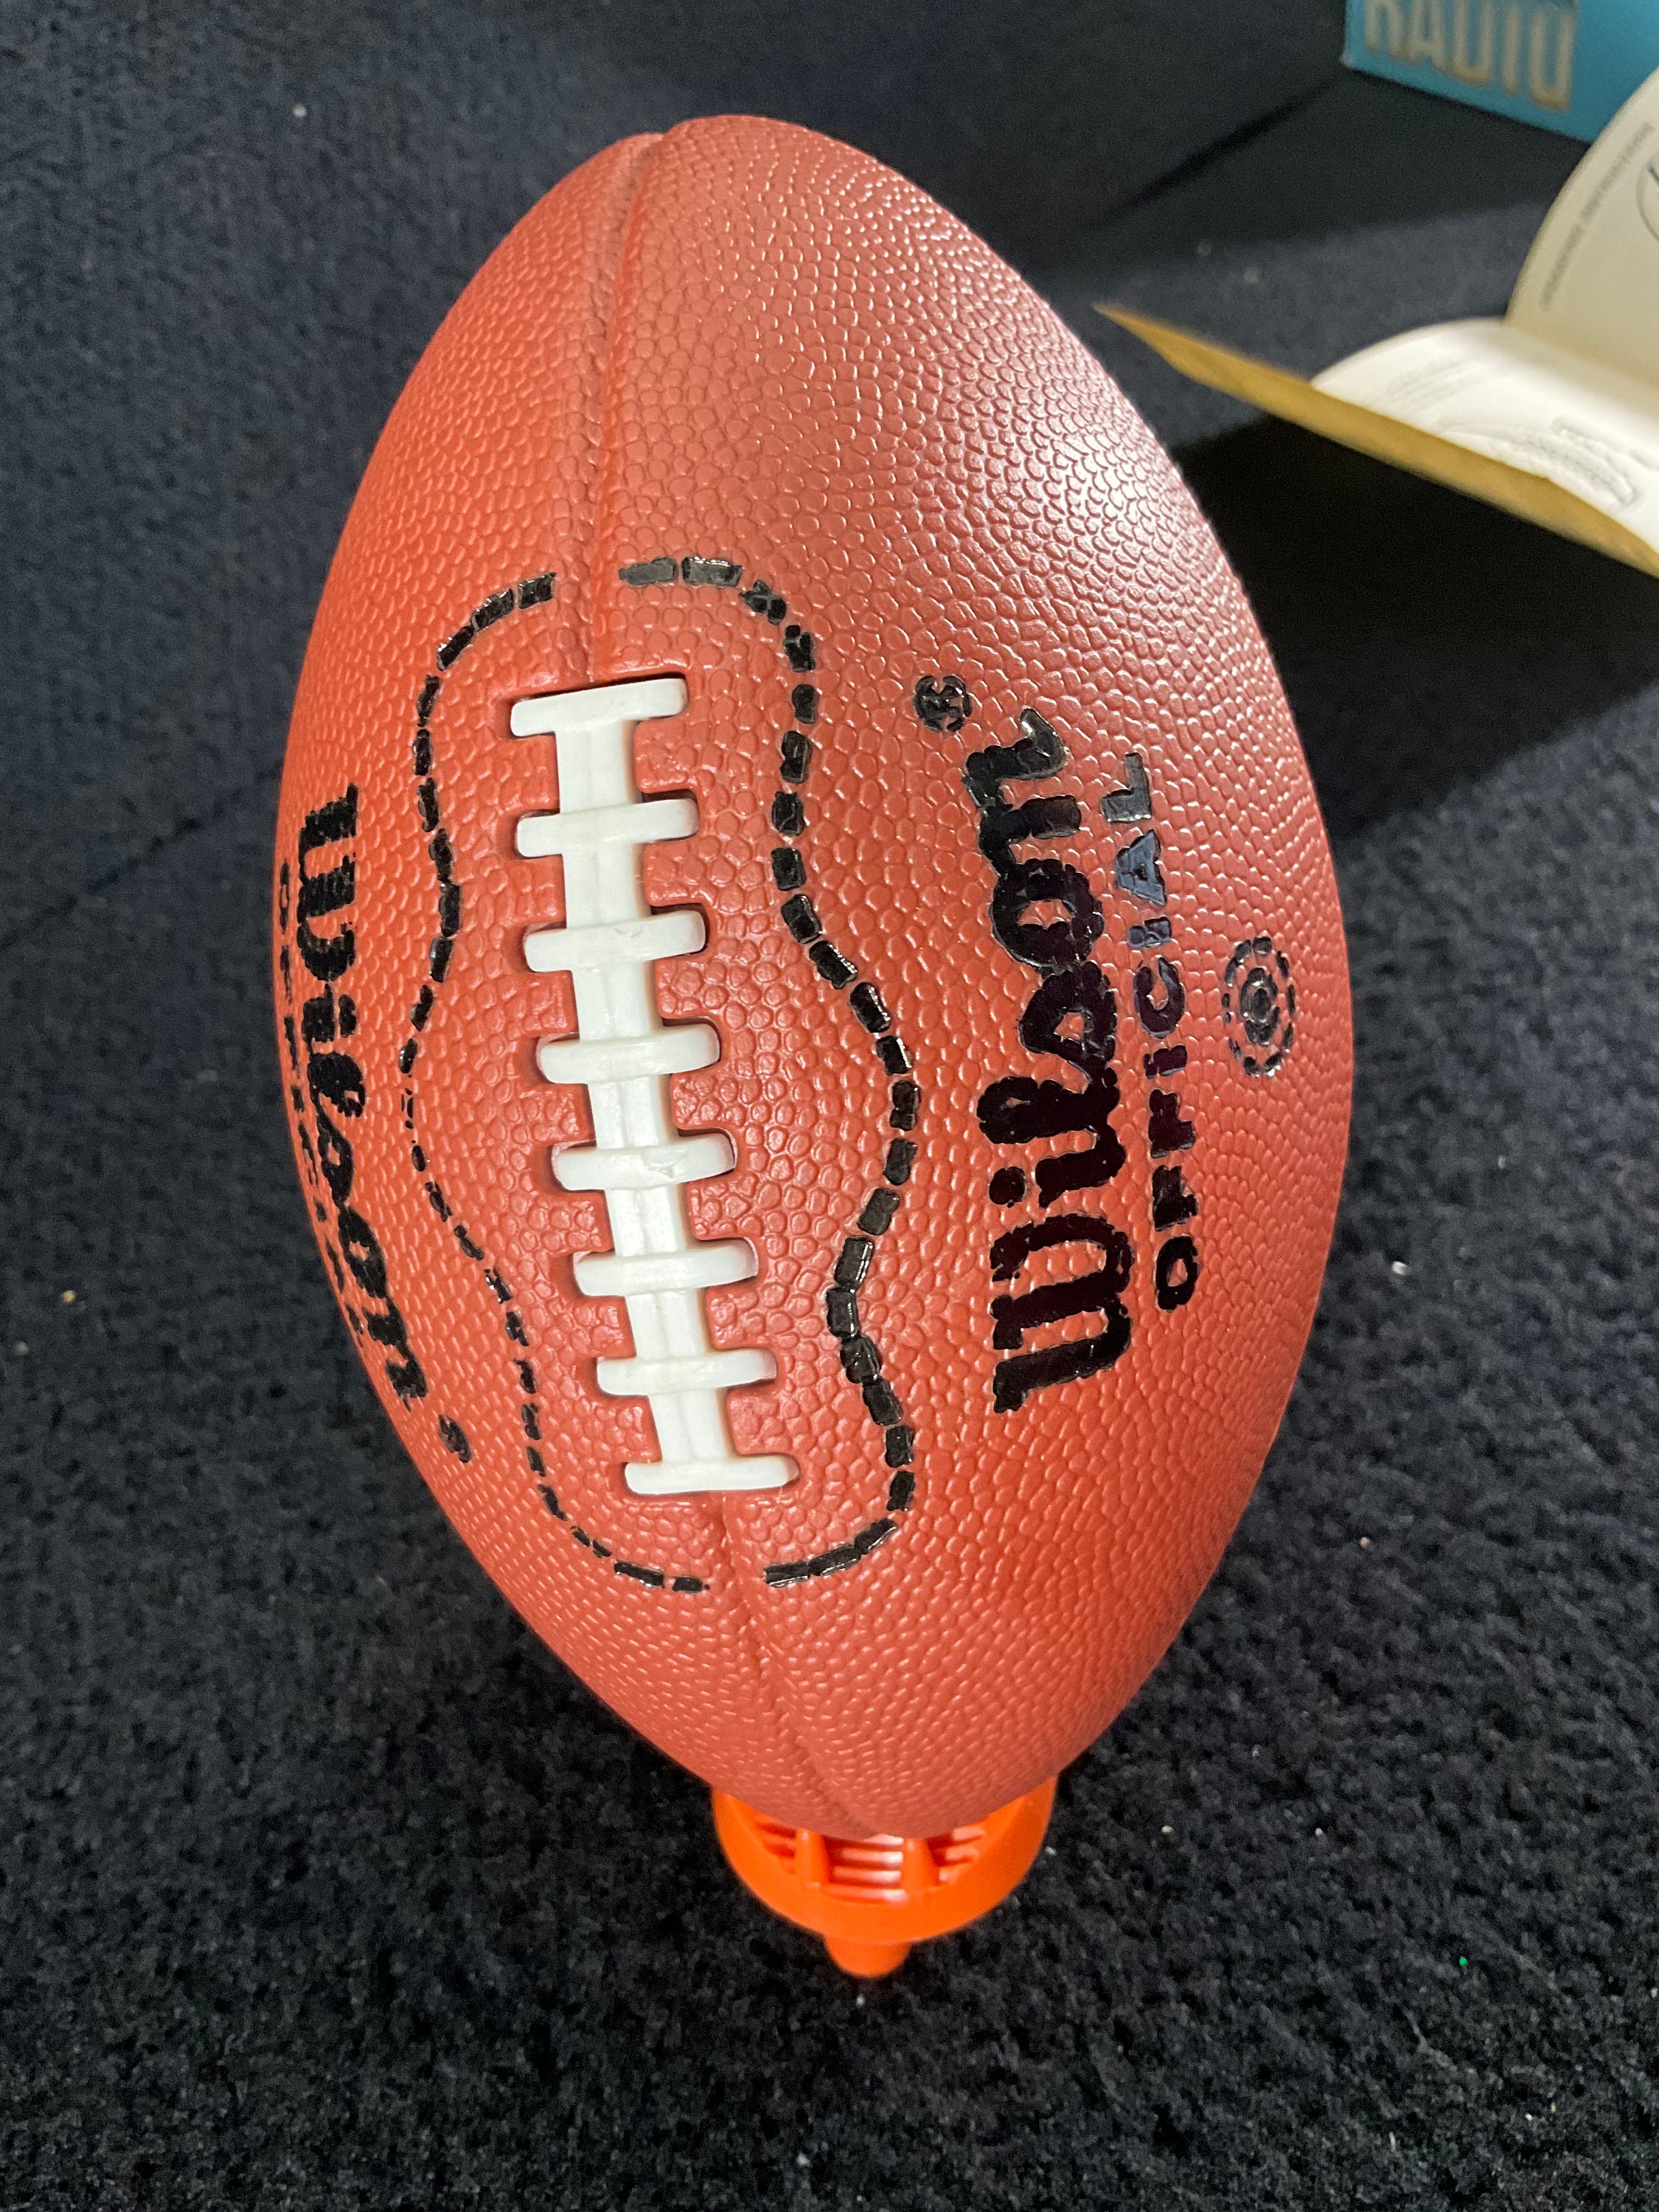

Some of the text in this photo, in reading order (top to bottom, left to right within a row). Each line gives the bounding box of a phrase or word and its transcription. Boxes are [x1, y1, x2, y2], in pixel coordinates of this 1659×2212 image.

[296, 782, 428, 1411] Wilson
[963, 708, 1134, 1412] Wilson
[1102, 753, 1200, 1311] OFFICIAL
